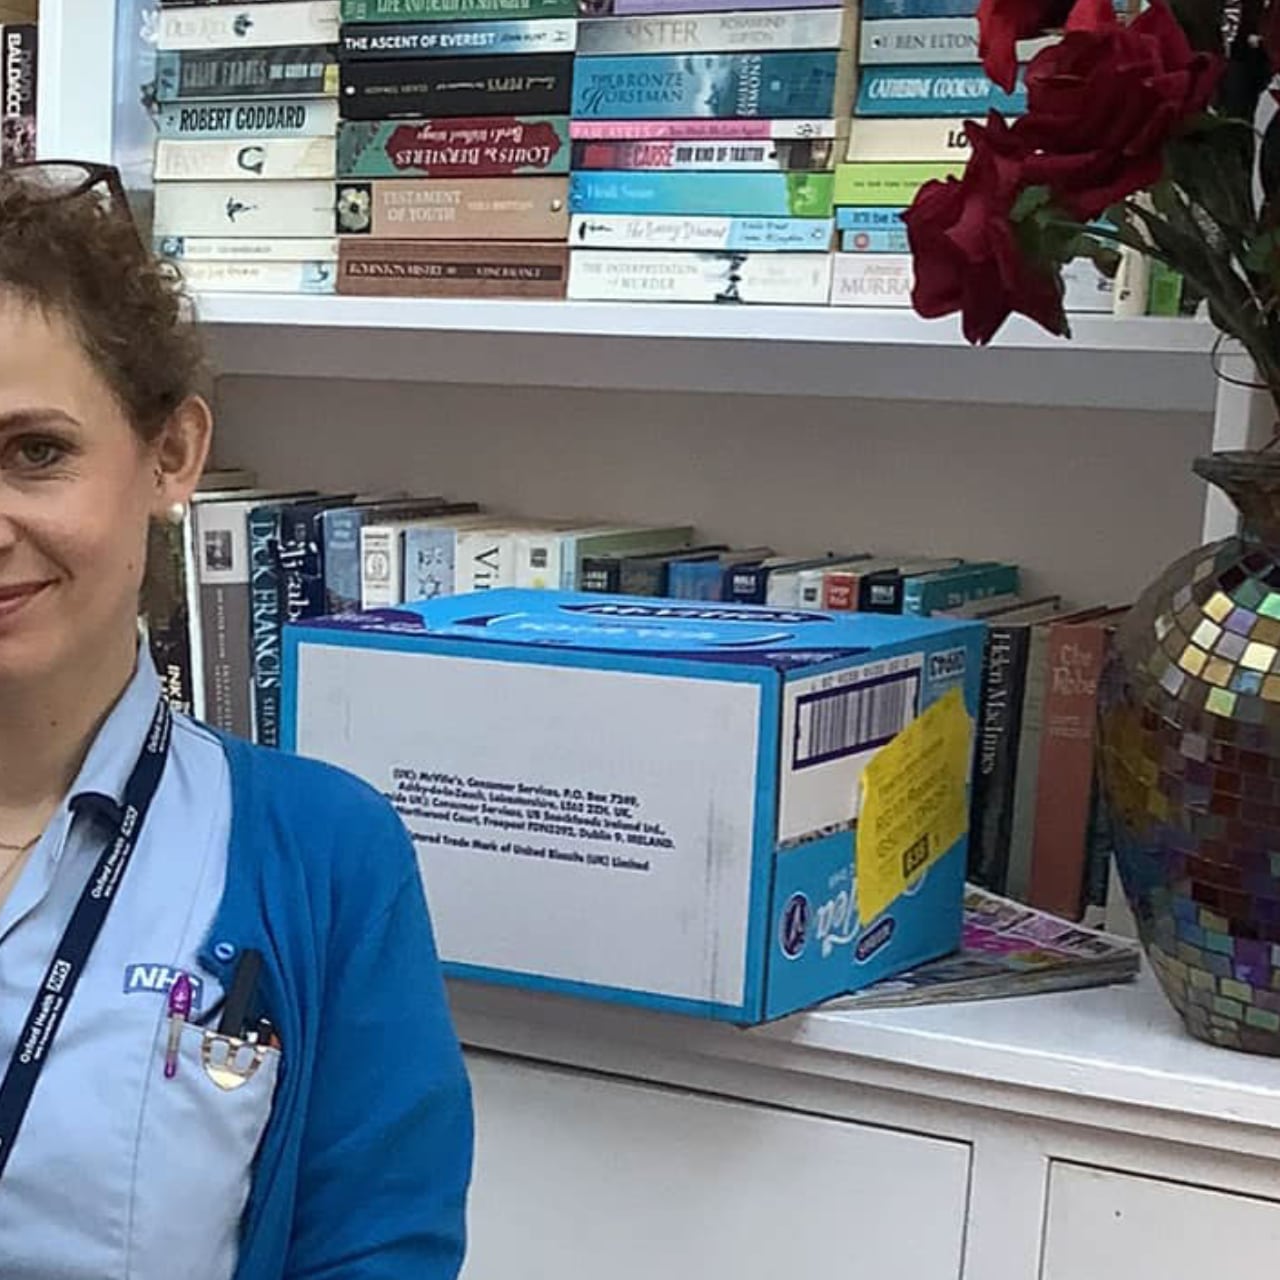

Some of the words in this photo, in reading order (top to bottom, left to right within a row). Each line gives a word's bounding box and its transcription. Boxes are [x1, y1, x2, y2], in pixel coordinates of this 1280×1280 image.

[344, 37, 368, 50] THE
[369, 35, 418, 49] ASCENT
[420, 34, 438, 48] OF
[440, 32, 496, 48] EVEREST
[894, 33, 926, 49] BEN
[930, 32, 980, 49] ELTON
[8, 33, 22, 118] BALDACCI
[179, 107, 233, 132] ROBERT
[235, 105, 306, 131] GODDARD
[947, 130, 969, 148] LO
[499, 146, 551, 163] LOUIS
[839, 278, 912, 296] MURRA
[249, 519, 275, 583] DICK
[474, 546, 500, 590] Vi
[252, 589, 280, 688] FRANCIS
[167, 664, 182, 698] INK
[263, 697, 276, 746] SHATT
[468, 777, 516, 791] Consumer
[587, 791, 607, 803] Box
[432, 797, 479, 812] Consumer
[579, 828, 612, 841] Dublin
[443, 835, 470, 848] Trade
[472, 840, 498, 852] Mark
[500, 843, 512, 853] of
[513, 844, 546, 858] United
[612, 856, 650, 872] Limited
[19, 1025, 41, 1064] Oxford
[34, 993, 56, 1027] Health
[45, 958, 72, 993] NHS
